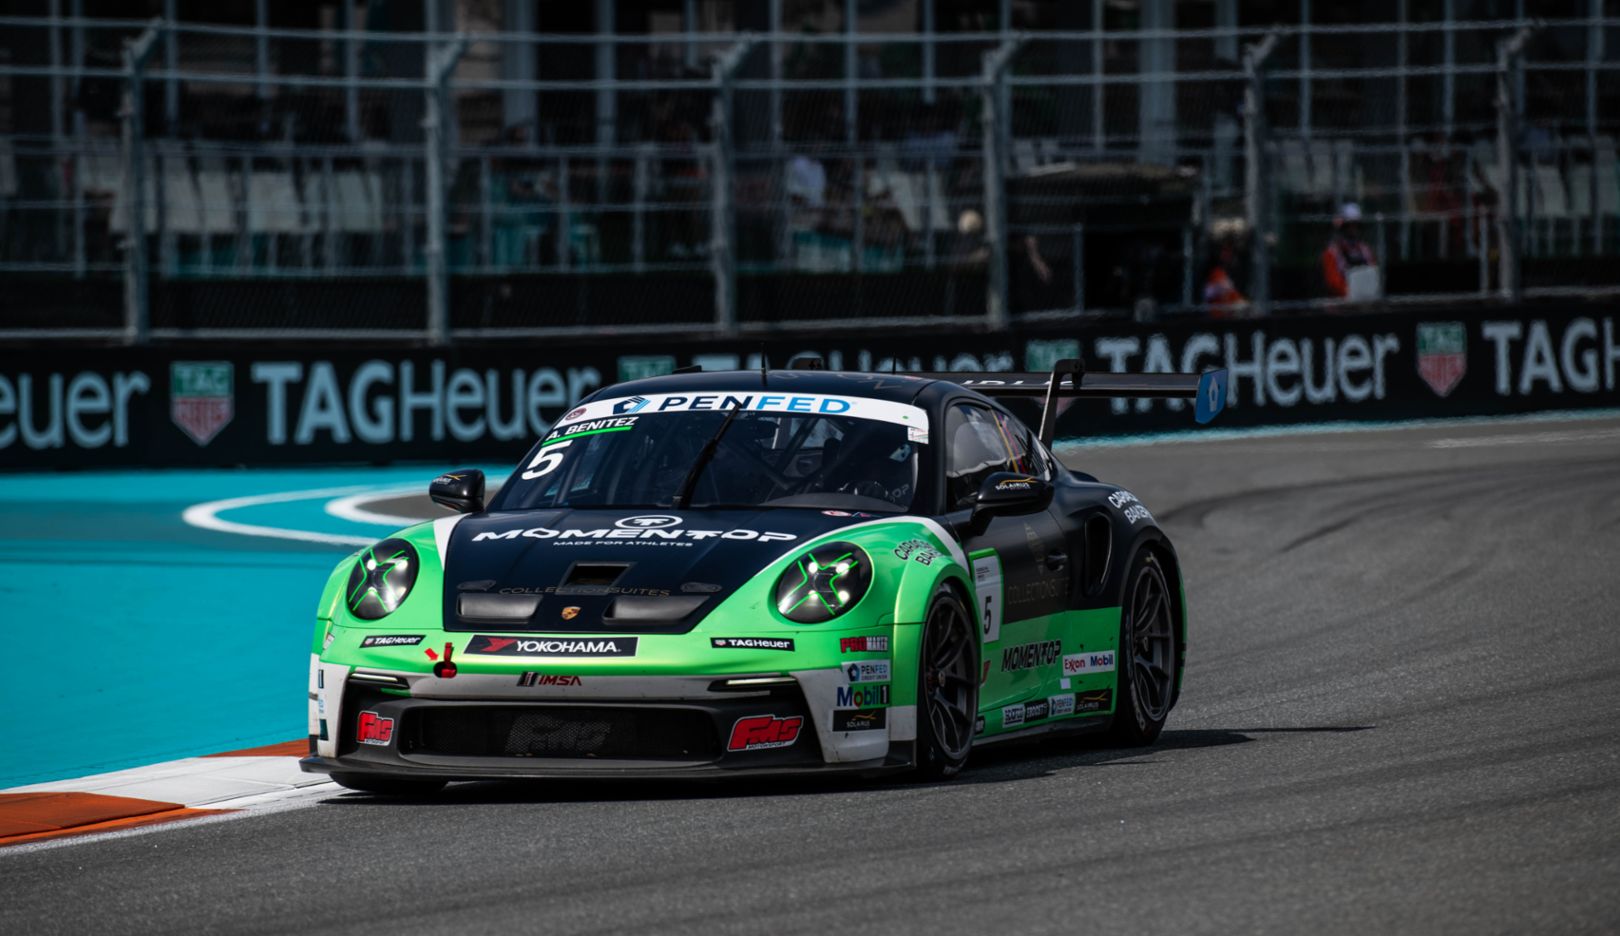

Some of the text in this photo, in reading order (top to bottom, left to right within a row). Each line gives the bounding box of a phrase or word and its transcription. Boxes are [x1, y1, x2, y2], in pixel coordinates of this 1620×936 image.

[1095, 330, 1400, 415] TAGHeuer
[251, 359, 600, 445] TAGHeuer
[658, 395, 851, 414] PENFED
[545, 416, 640, 441] A. BENITEZ
[521, 439, 574, 480] 5
[471, 527, 798, 543] MOMENTOP
[983, 595, 993, 635] 5
[374, 636, 422, 645] TAGHeuer
[516, 640, 618, 653] YOKOHAMA
[728, 639, 791, 648] TAGHeuer
[1001, 639, 1062, 672] MOMENTOP
[1064, 653, 1114, 673] Exxon Mobil
[538, 675, 582, 687] IMSA
[837, 685, 880, 707] Mobil
